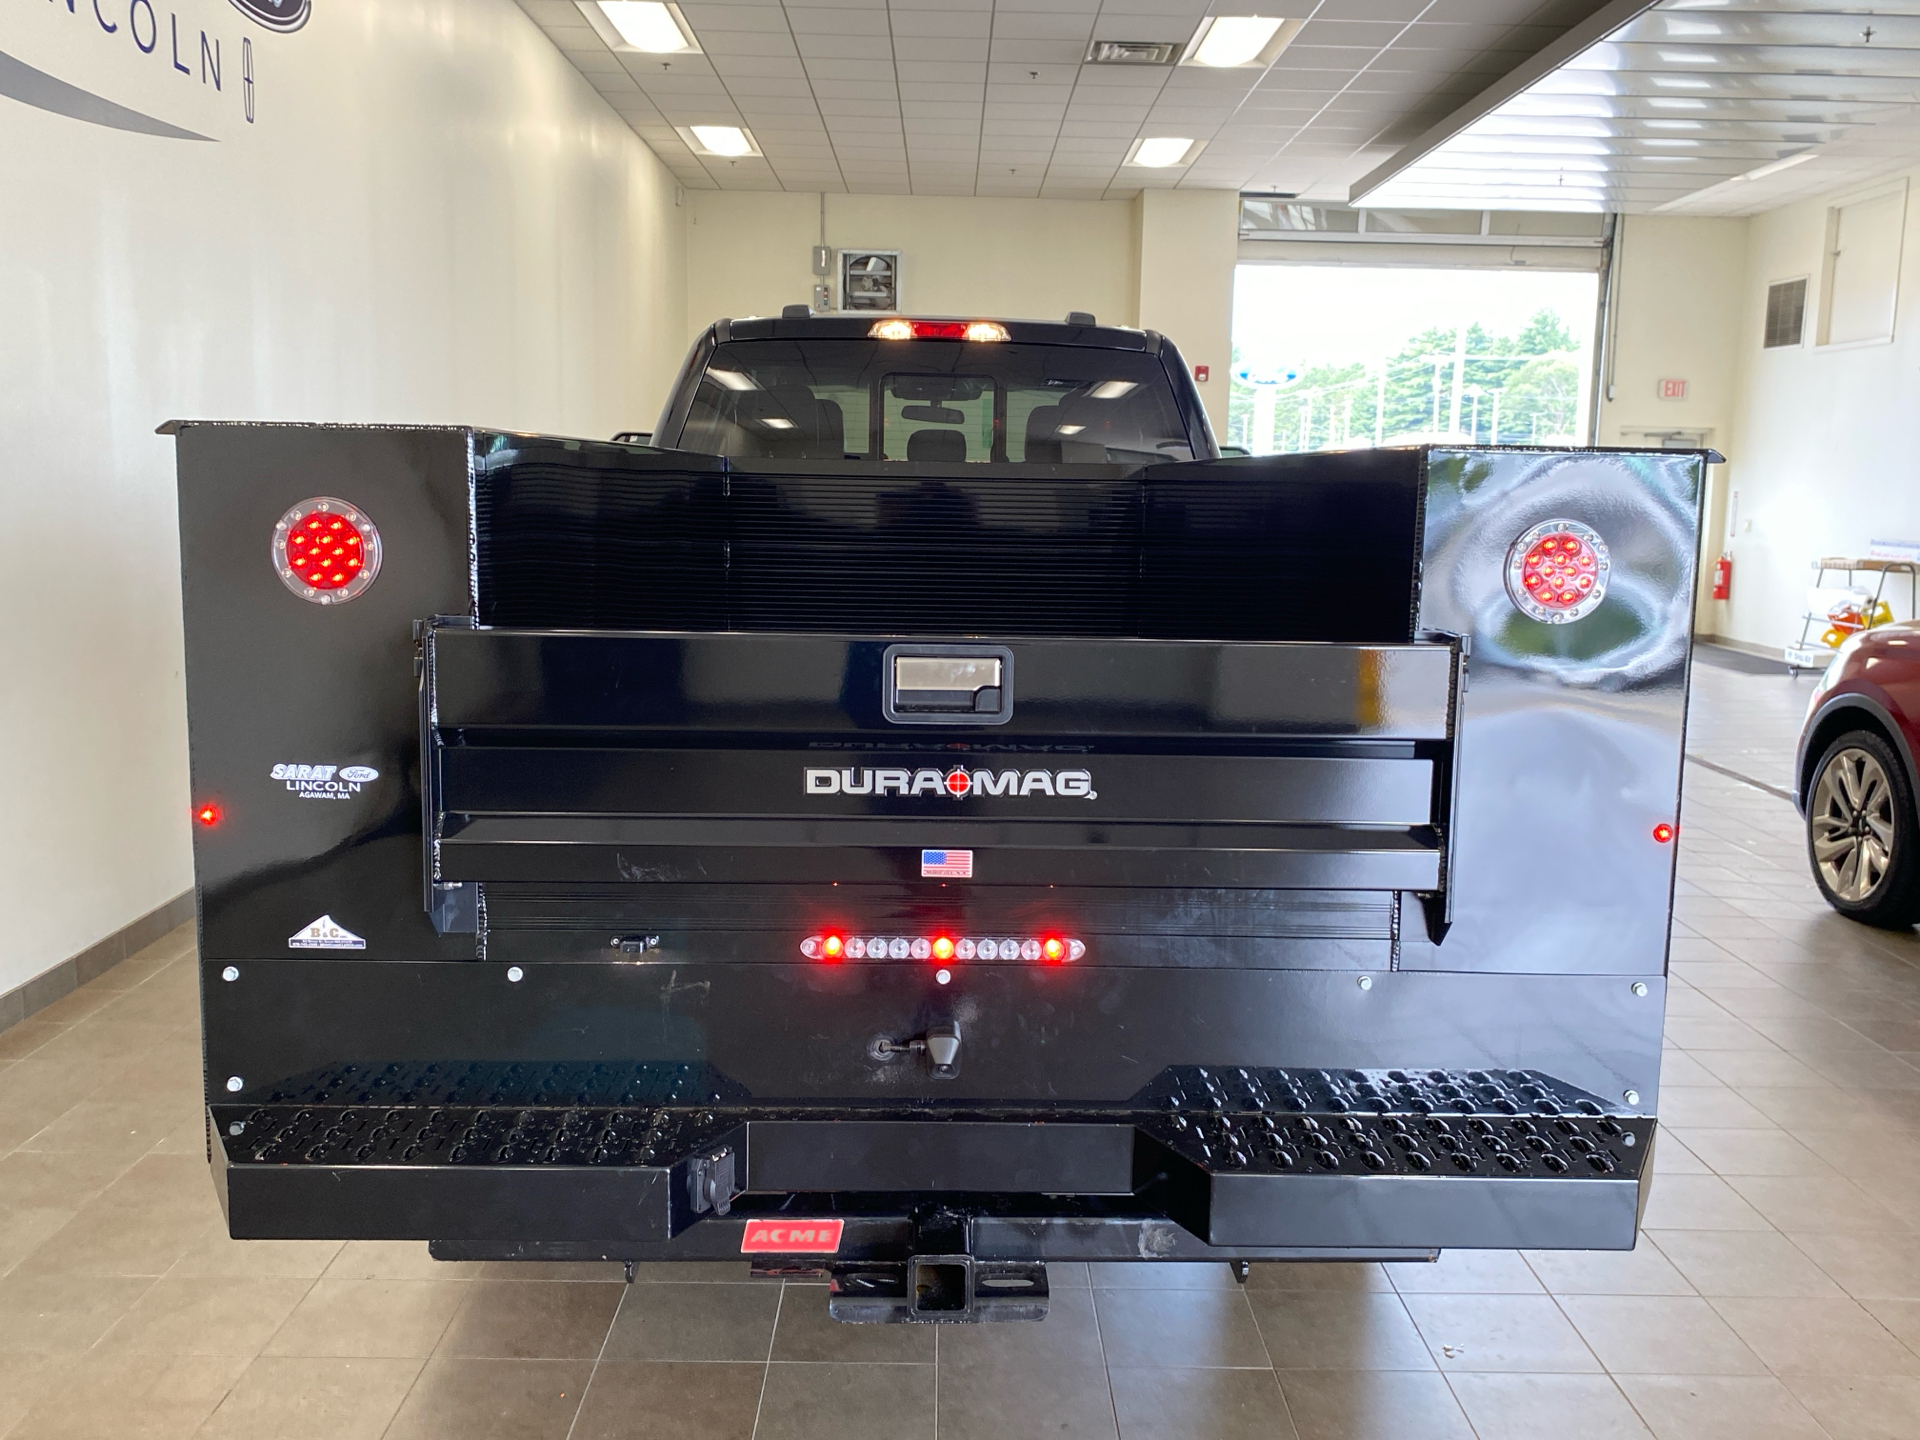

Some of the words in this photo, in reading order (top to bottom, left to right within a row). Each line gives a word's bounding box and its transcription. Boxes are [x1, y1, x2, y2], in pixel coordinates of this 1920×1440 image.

[48, 0, 221, 91] COLN
[1664, 380, 1687, 398] EXIT
[270, 764, 337, 781] SARAT
[286, 780, 361, 793] LINCOLN
[299, 791, 336, 800] AGAWAM,
[337, 792, 351, 800] MA
[750, 1229, 835, 1243] ACME
